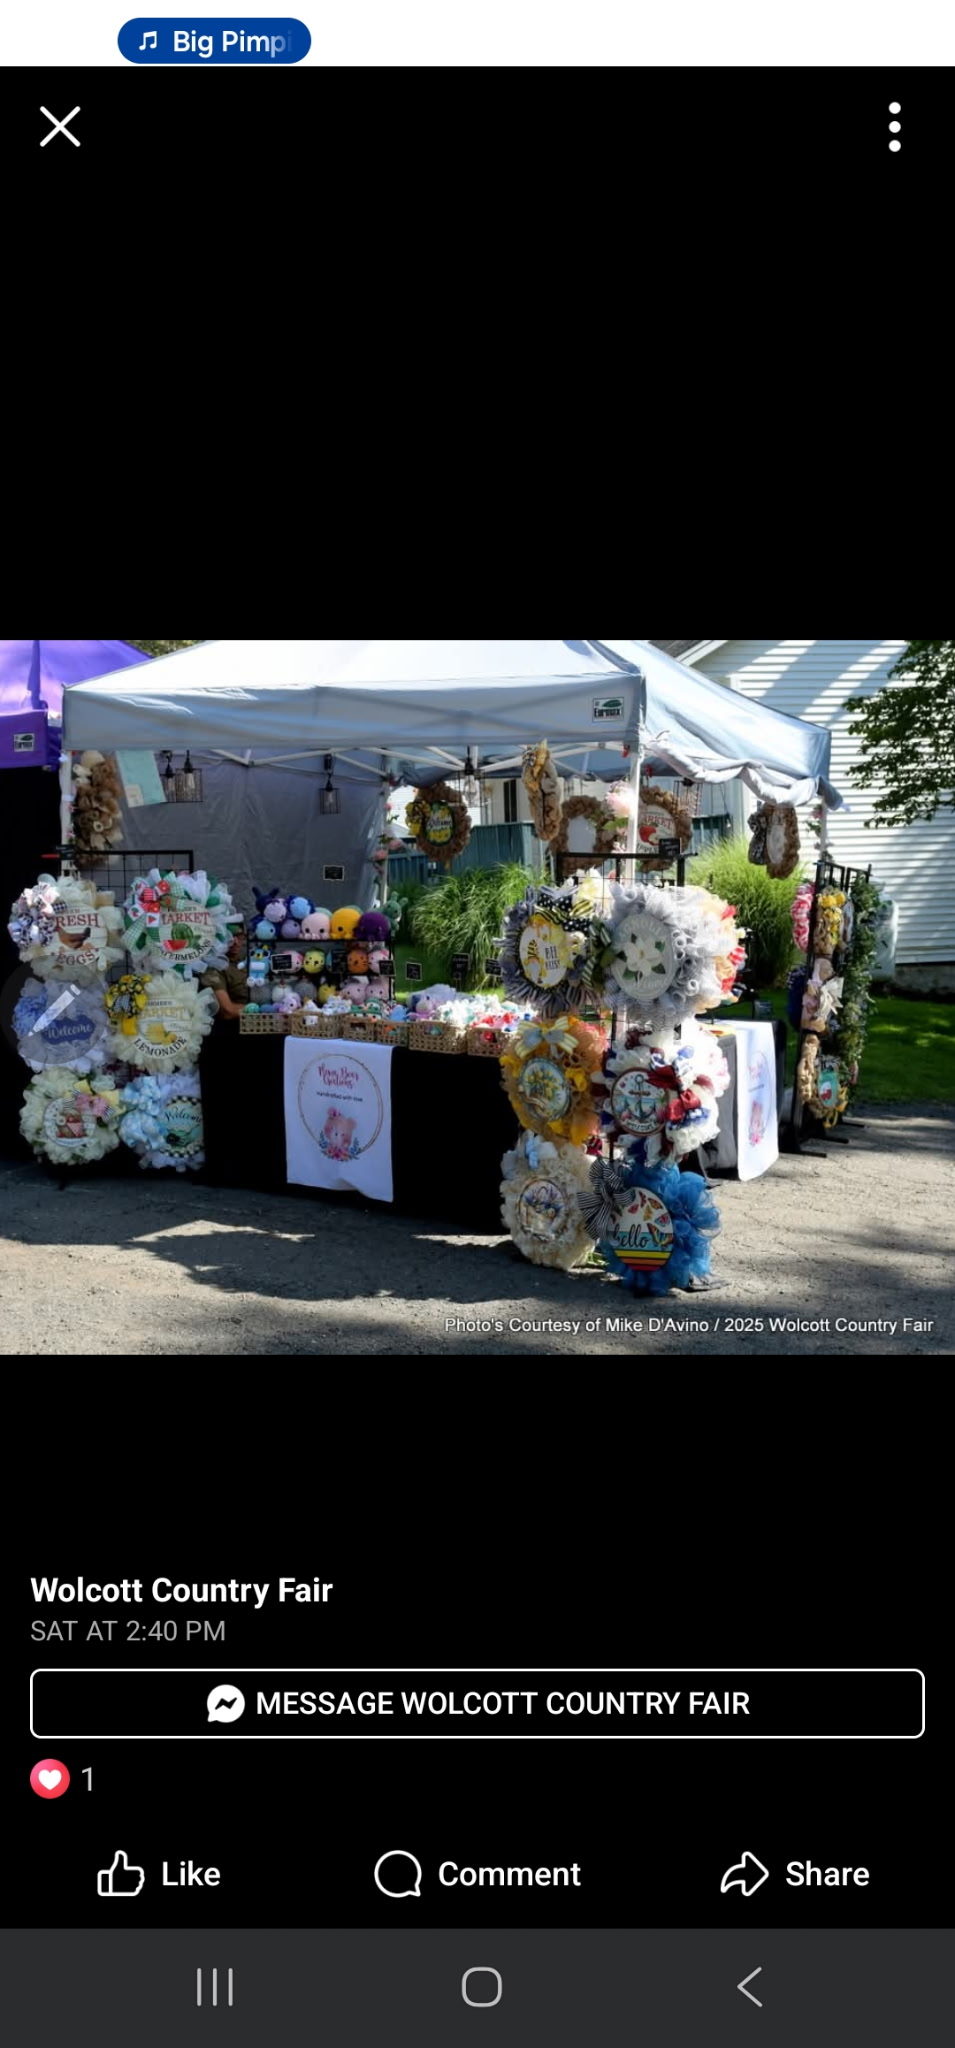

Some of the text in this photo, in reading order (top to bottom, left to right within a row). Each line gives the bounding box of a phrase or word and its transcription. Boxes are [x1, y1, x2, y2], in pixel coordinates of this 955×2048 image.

[173, 30, 213, 58] Big
[56, 950, 96, 966] EGGS
[46, 1022, 93, 1039] Welcome
[134, 1036, 188, 1057] LEMONADE
[31, 1577, 334, 1609] Wolcott Country Fair
[30, 1620, 226, 1642] SAT AT 2:40 PM
[256, 1691, 751, 1715] MESSAGE WOLCOTT COUNTRY FAIR
[81, 1767, 93, 1792] 1
[162, 1859, 221, 1887] Like
[438, 1860, 582, 1887] Comment
[785, 1859, 870, 1887] Share
